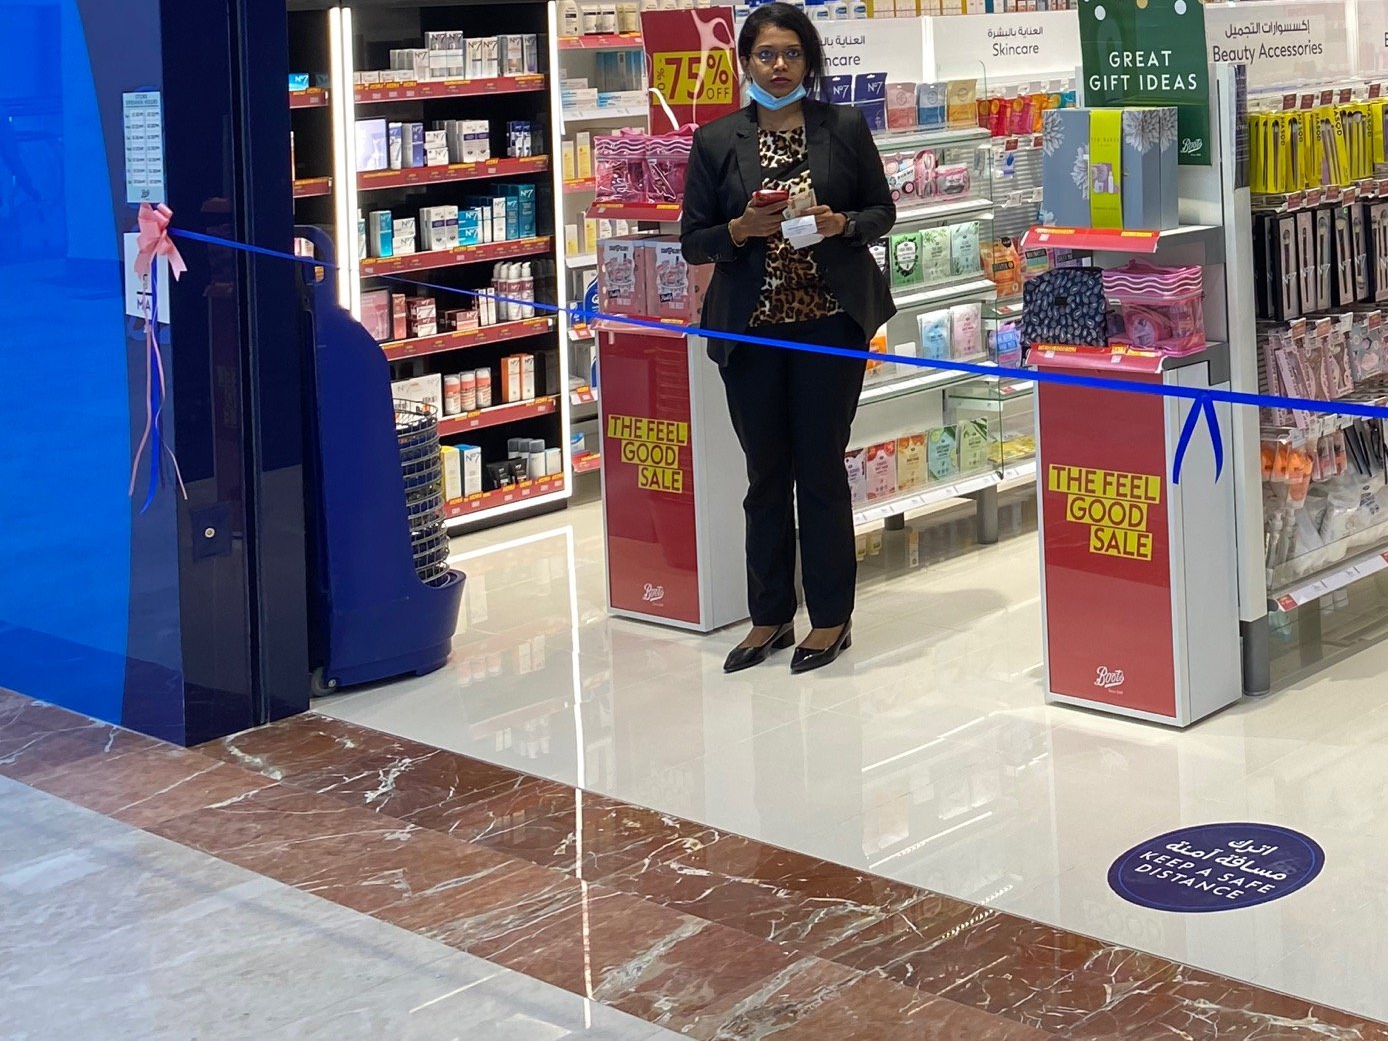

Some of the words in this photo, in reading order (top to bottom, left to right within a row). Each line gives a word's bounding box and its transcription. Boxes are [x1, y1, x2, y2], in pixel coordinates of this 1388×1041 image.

[824, 53, 861, 67] ncare
[992, 42, 1040, 57] Skincare
[1108, 50, 1172, 68] GREAT
[1212, 45, 1256, 65] Beauty
[1258, 40, 1323, 59] Accessories
[706, 87, 730, 100] OFF
[1089, 74, 1131, 92] GIFT
[1138, 73, 1198, 91] IDEAS
[1180, 137, 1203, 154] Boots
[610, 416, 643, 438] THE
[646, 419, 687, 444] FEEL
[623, 441, 677, 467] GOOD
[640, 467, 682, 492] SALE
[1051, 465, 1097, 495] THE
[1102, 471, 1157, 502] FEEL
[1069, 497, 1144, 528] GOOD
[1092, 528, 1151, 559] SALE
[1094, 665, 1125, 689] Boots
[1165, 840, 1224, 860] آمنة
[1228, 839, 1279, 856] اترك
[1139, 851, 1195, 869] KEEP
[1195, 868, 1213, 877] A
[1217, 873, 1276, 894] SAFE
[1214, 854, 1287, 881] مسافة
[1134, 863, 1245, 900] DISTANCE
